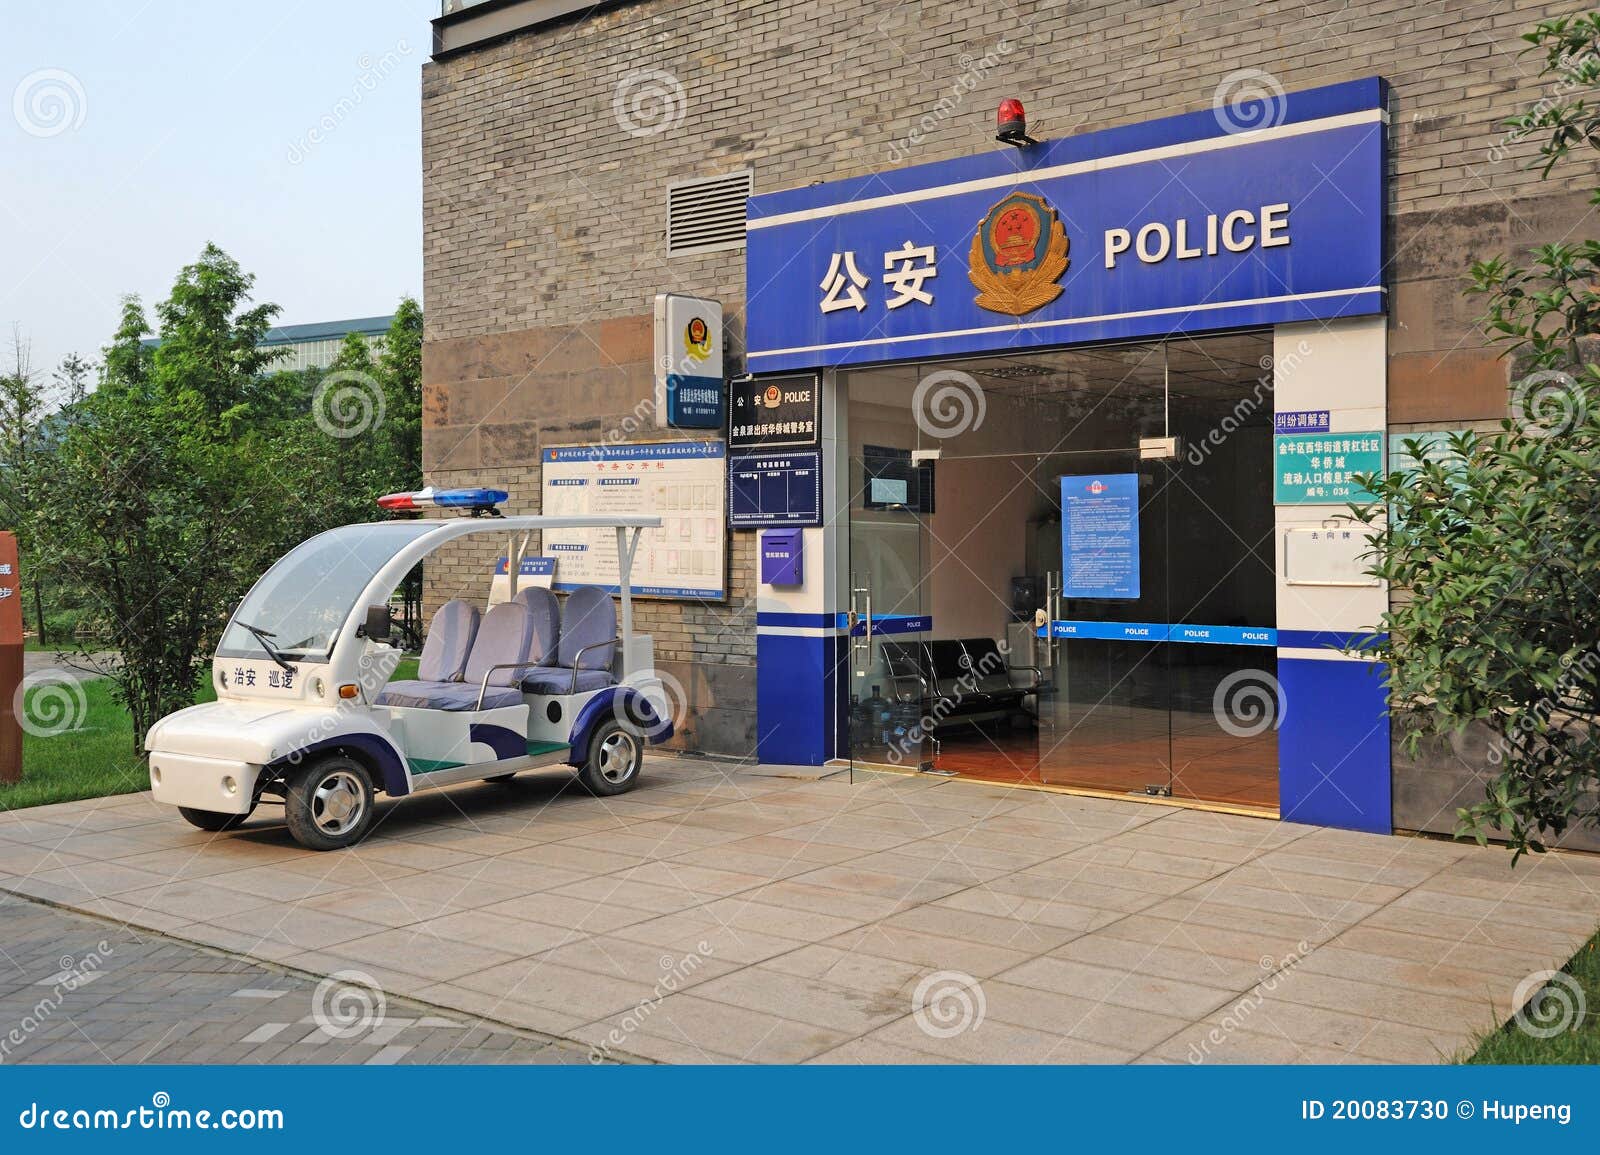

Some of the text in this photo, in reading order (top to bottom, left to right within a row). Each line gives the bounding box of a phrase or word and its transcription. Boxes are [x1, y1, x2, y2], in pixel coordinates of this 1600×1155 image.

[1104, 202, 1292, 269] POLICE
[818, 240, 938, 314] 公安
[784, 390, 811, 404] POLICE
[1277, 412, 1329, 428] 纠纷调解室
[1311, 456, 1346, 469] 华侨城
[1054, 625, 1269, 641] POLICE POLICE POLICE POLICE
[234, 667, 257, 687] 治安
